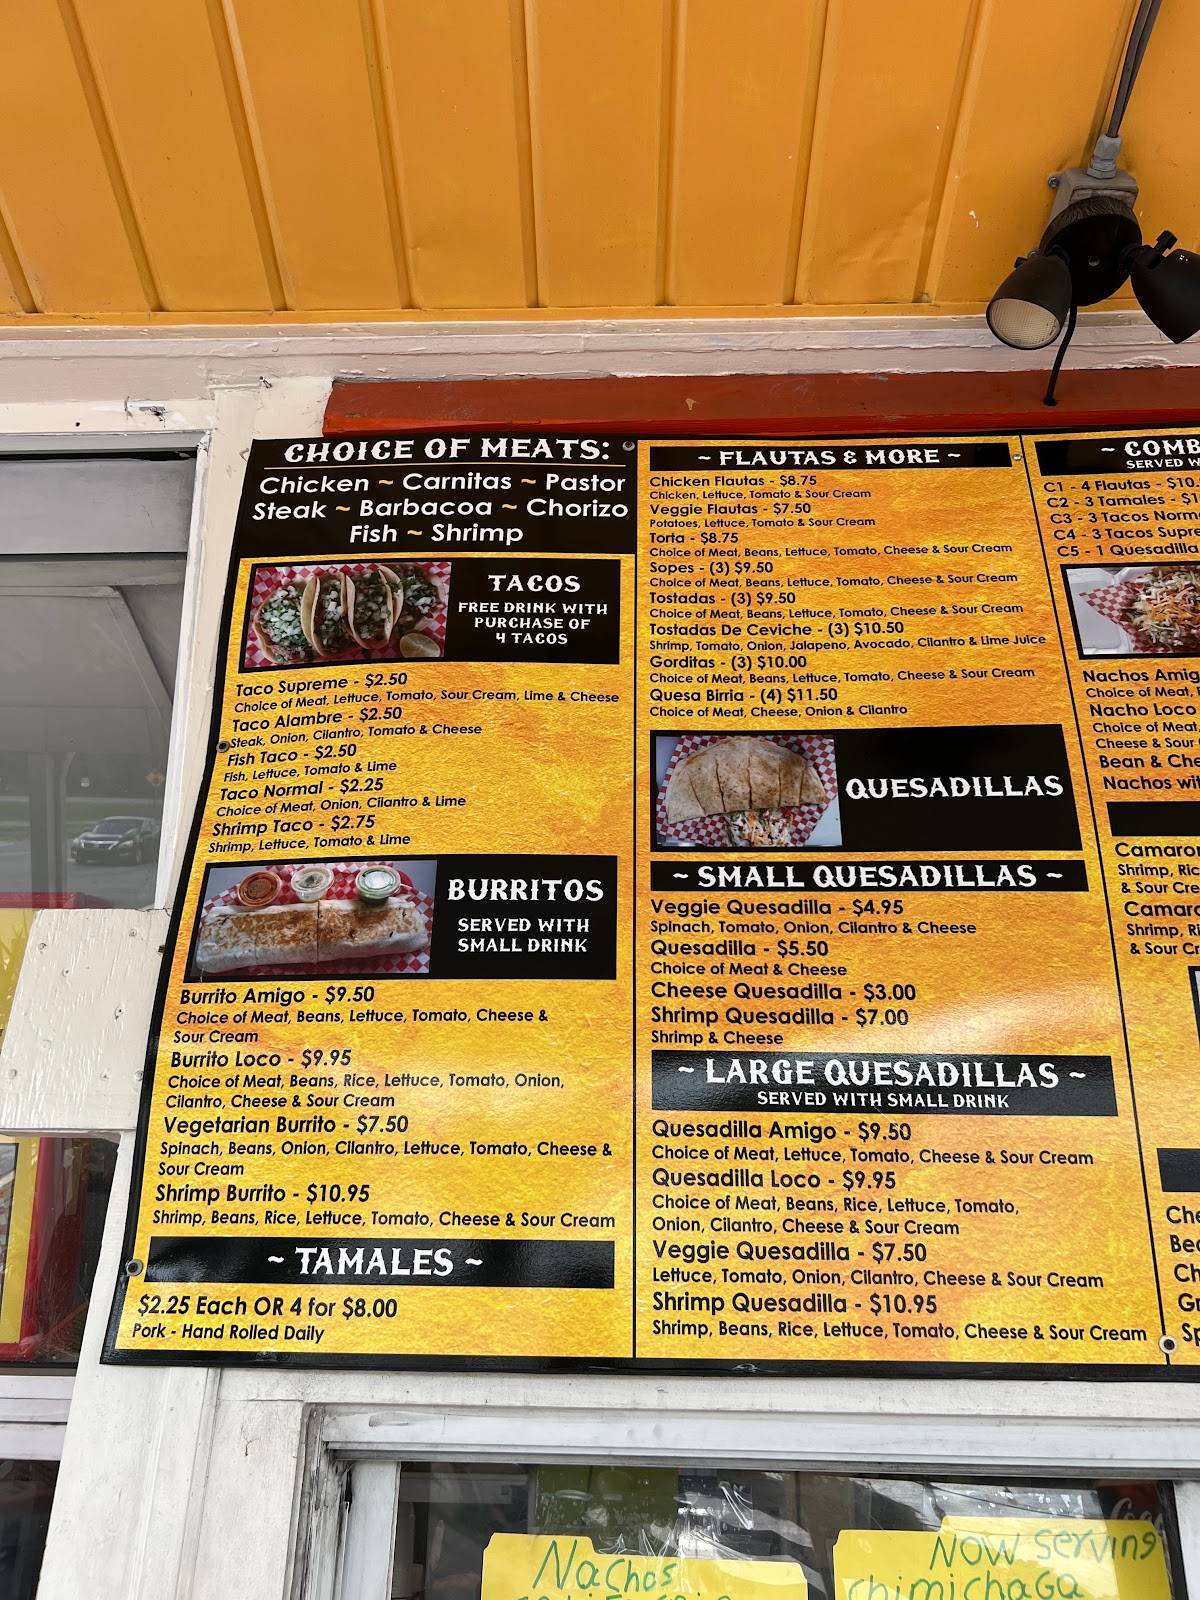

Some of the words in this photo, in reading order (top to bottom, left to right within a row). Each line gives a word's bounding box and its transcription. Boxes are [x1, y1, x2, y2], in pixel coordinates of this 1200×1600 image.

[284, 440, 413, 463] CHOICE
[424, 438, 471, 459] OF
[481, 438, 610, 460] MEATS:
[720, 450, 836, 466] FLAUTAS
[843, 450, 857, 464] &
[865, 448, 940, 464] MORE
[1126, 458, 1184, 469] SERVED
[260, 476, 369, 494] Chicken
[402, 472, 512, 490] Carnitas
[546, 473, 626, 492] Pastor
[1043, 482, 1063, 492] C1
[1081, 480, 1091, 491] 4
[1094, 479, 1151, 491] Flautas
[650, 491, 699, 500] Chicken,
[702, 490, 746, 500] Lettuce,
[749, 490, 791, 498] Tomato
[794, 490, 802, 498] &
[805, 489, 830, 498] Sour
[832, 489, 871, 498] Cream
[252, 500, 327, 520] Steak
[360, 498, 492, 516] Barbacoa
[526, 498, 628, 518] Chorizo
[350, 524, 397, 543] Fish
[431, 523, 524, 546] Shrimp
[649, 532, 685, 544] Torta
[700, 532, 738, 545] $8.75
[1057, 545, 1080, 557] C5
[1096, 545, 1104, 556] 1
[1110, 542, 1199, 556] Quesadilla
[488, 574, 580, 592] TACOS
[458, 602, 500, 612] FREE
[504, 602, 556, 613] DRINK
[562, 603, 608, 615] WITH
[474, 617, 564, 629] PURCHASE
[568, 618, 590, 630] OF
[496, 632, 506, 643] 4
[511, 632, 568, 644] TACOS
[650, 640, 692, 652] Shrimp,
[696, 641, 743, 652] Tomato,
[746, 640, 786, 651] Onion,
[790, 640, 850, 652] Jalapeno,
[854, 638, 914, 649] Avocado,
[917, 636, 965, 647] Cilantro
[969, 636, 978, 646] &
[980, 635, 1010, 645] Lime
[1013, 634, 1046, 644] Juice
[236, 684, 274, 697] Taco
[278, 678, 348, 694] Supreme
[364, 672, 408, 688] $2.50
[1082, 669, 1150, 682] Nachos
[650, 688, 701, 702] Quesa
[706, 688, 744, 702] Birria
[760, 688, 782, 704] (4)
[787, 688, 838, 703] $11.50
[1086, 687, 1134, 698] Choice
[1138, 686, 1151, 697] of
[1155, 686, 1194, 698] Meat,
[234, 700, 278, 713] Choice
[280, 698, 293, 709] of
[295, 695, 330, 708] Meat,
[334, 693, 382, 704] Lettuce,
[386, 690, 436, 701] Tomato,
[440, 690, 469, 700] Sour
[472, 690, 520, 701] Cream,
[524, 690, 554, 701] Lime
[557, 692, 566, 701] &
[570, 691, 620, 702] Cheese
[229, 736, 265, 749] Steak,
[270, 732, 308, 744] Onion,
[313, 728, 364, 740] Cilantro,
[368, 724, 416, 736] Tomato
[419, 724, 428, 734] &
[432, 724, 482, 734] Cheese
[1099, 755, 1145, 768] Bean
[1150, 755, 1163, 768] &
[224, 771, 248, 782] Fish,
[252, 768, 300, 780] Lettuce,
[304, 763, 350, 776] Tomato
[354, 762, 363, 772] &
[367, 761, 397, 772] Lime
[845, 775, 1064, 800] QUESADILLAS
[212, 822, 268, 837] Shrimp
[273, 819, 313, 832] Taco
[330, 814, 376, 832] $2.75
[698, 866, 805, 888] SMALL
[812, 864, 1037, 888] QUESADILLAS
[1118, 863, 1173, 878] Shrimp,
[448, 878, 604, 902] BURRITOS
[650, 899, 720, 918] Veggie
[726, 899, 832, 915] Quesadilla
[852, 898, 904, 917] $4.95
[458, 918, 532, 932] SERVED
[538, 918, 589, 932] WITH
[458, 938, 522, 952] SMALL
[528, 938, 587, 952] DRINK
[180, 988, 237, 1004] Burrito
[242, 987, 305, 1007] Amigo
[324, 985, 374, 1005] $9.50
[173, 1030, 205, 1044] Sour
[209, 1030, 258, 1043] Cream
[651, 1030, 704, 1047] Shrimp
[708, 1032, 719, 1044] &
[724, 1031, 784, 1044] Cheese
[706, 1059, 815, 1085] LARGE
[824, 1058, 1060, 1090] QUESADILLAS
[757, 1090, 827, 1106] SERVED
[832, 1092, 882, 1106] WITH
[887, 1092, 949, 1108] SMALL
[953, 1094, 1010, 1108] DRINK
[164, 1116, 270, 1138] Vegetarian
[276, 1115, 336, 1133] Burrito
[356, 1114, 408, 1136] $7.50
[652, 1168, 764, 1187] Quesadilla
[771, 1170, 820, 1188] Loco
[842, 1169, 896, 1192] $9.95
[294, 1246, 454, 1276] TAMALES
[138, 1294, 190, 1317] $2.25
[196, 1296, 247, 1315] Each
[254, 1296, 284, 1316] OR
[290, 1297, 302, 1316] 4
[308, 1297, 336, 1316] for
[342, 1296, 397, 1320] $8.00
[132, 1323, 166, 1338] Pork
[182, 1324, 224, 1339] Hand
[230, 1324, 279, 1340] Rolled
[284, 1325, 324, 1344] Daily
